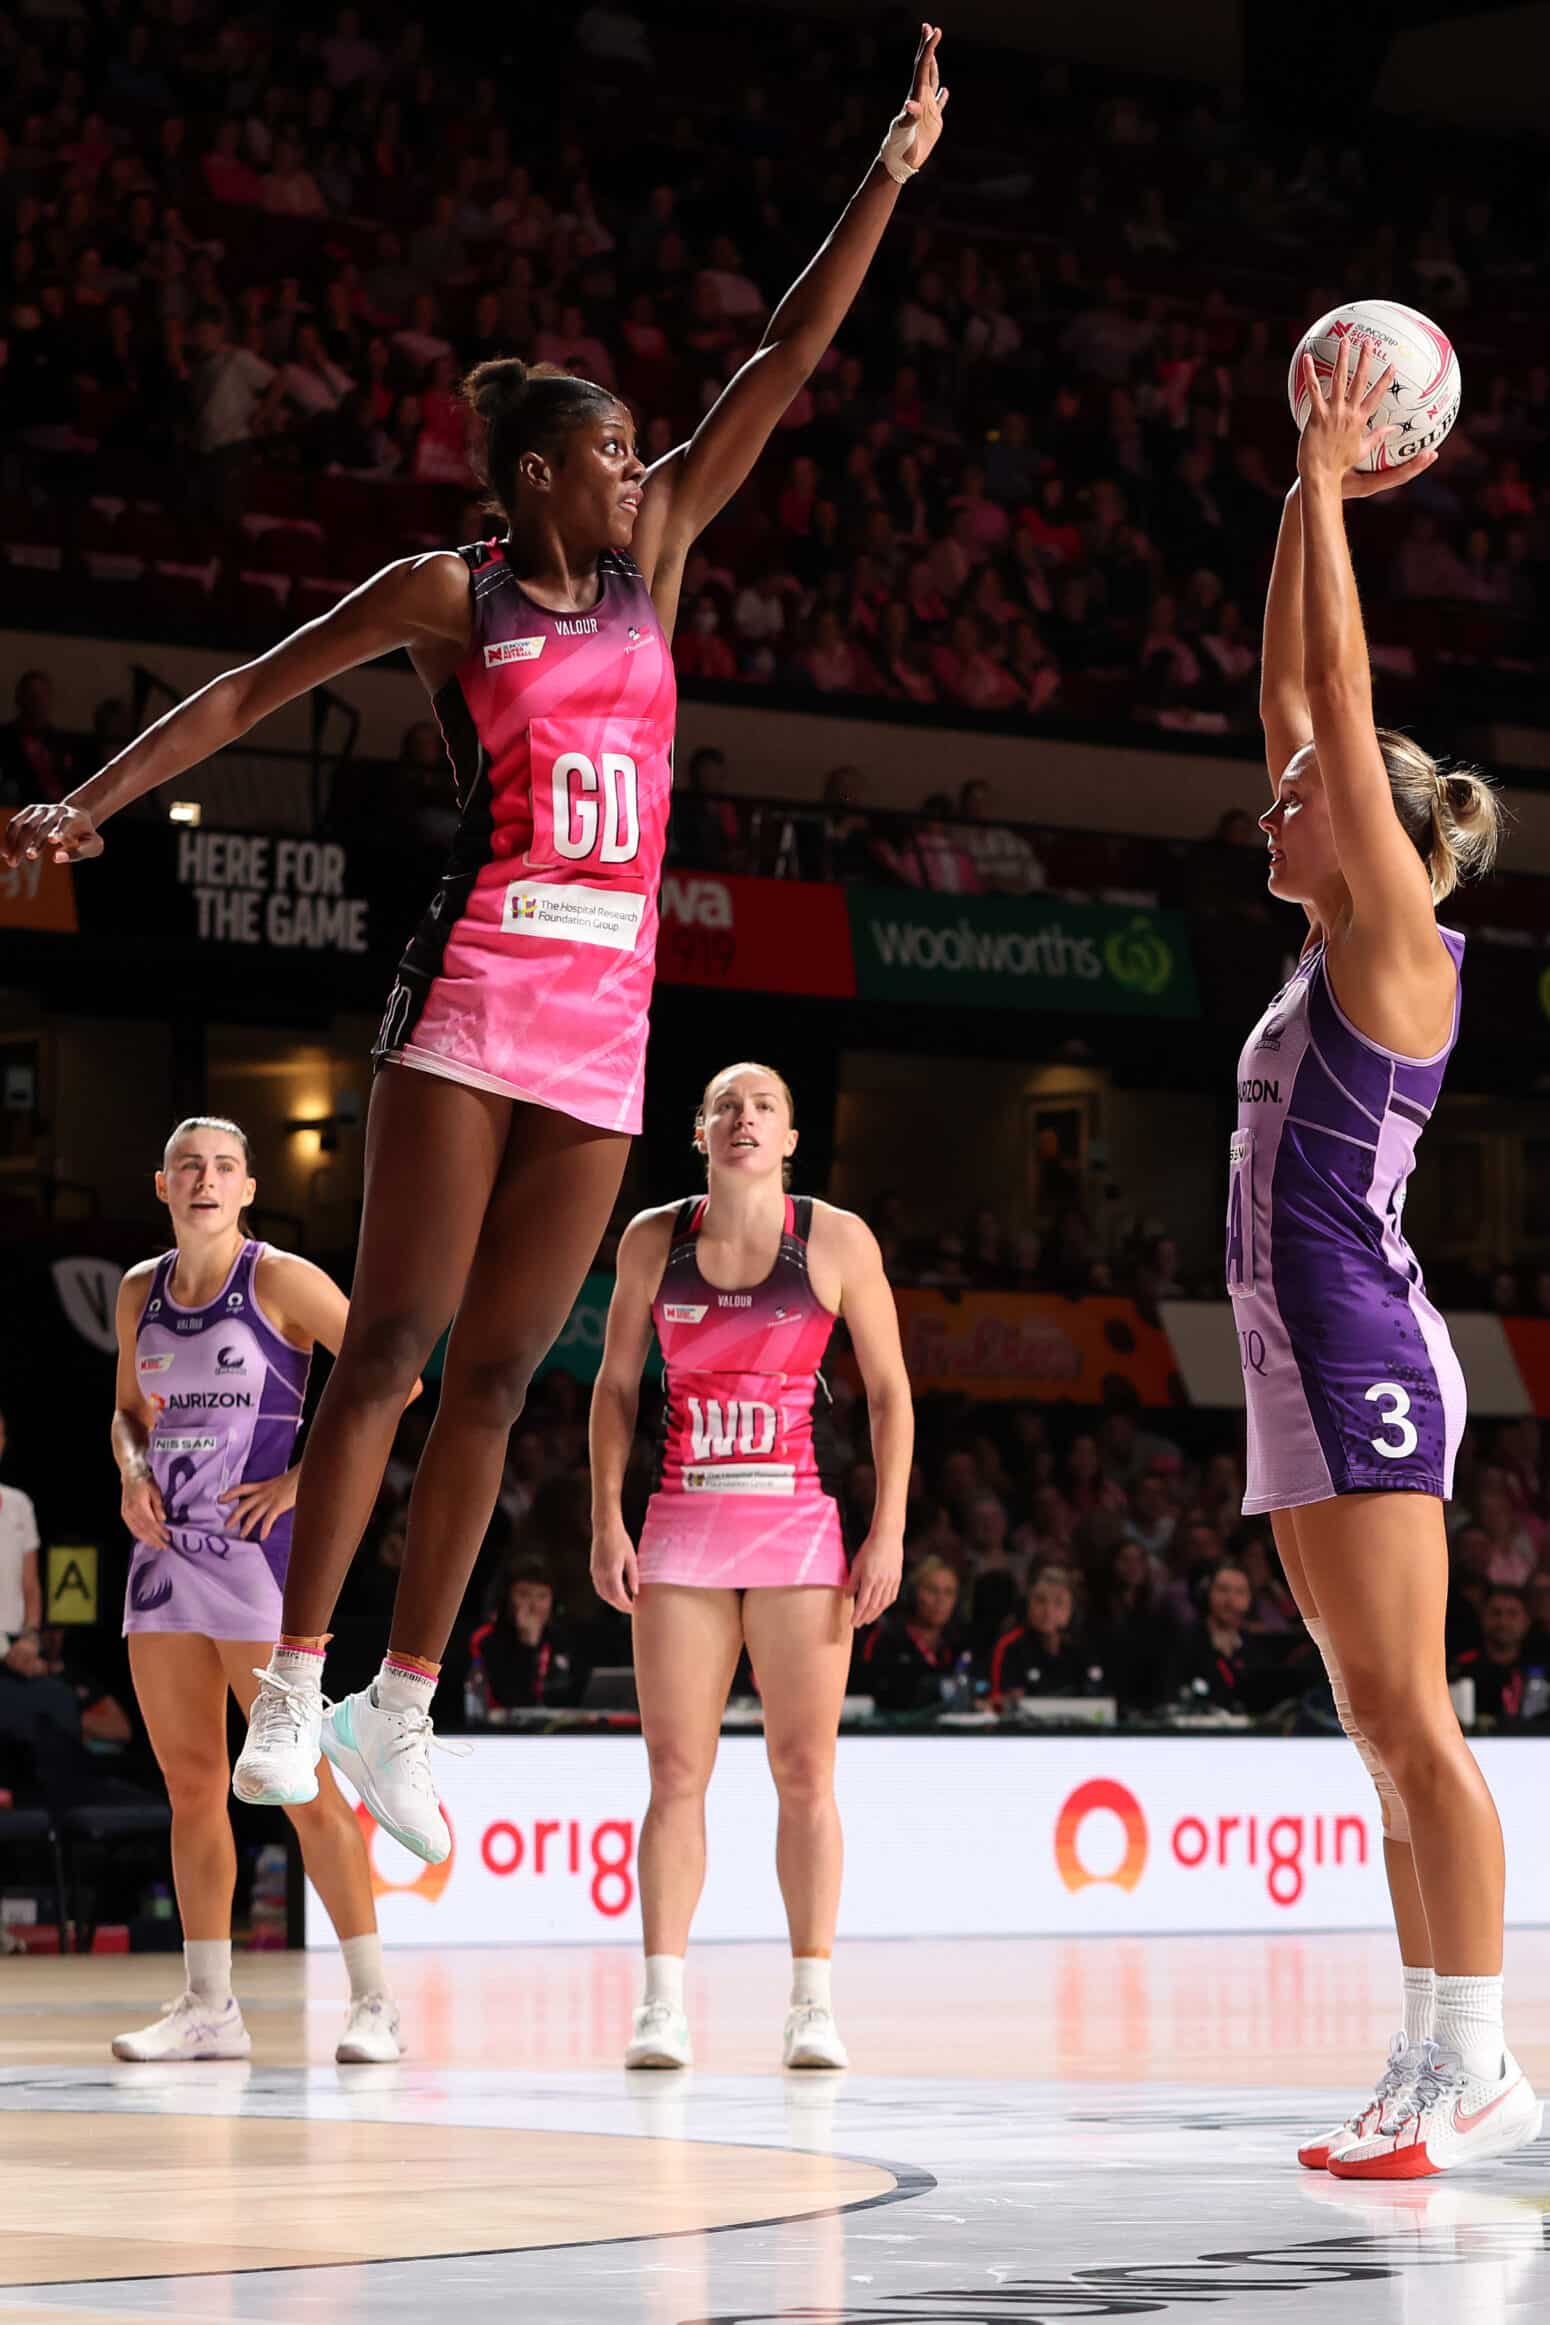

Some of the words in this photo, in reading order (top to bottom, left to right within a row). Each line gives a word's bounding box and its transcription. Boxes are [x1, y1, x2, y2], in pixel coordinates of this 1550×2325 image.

[1349, 336, 1387, 361] NEALL
[555, 618, 598, 636] VALOUR
[552, 752, 640, 863] GD
[177, 831, 268, 886] HERE
[276, 841, 345, 896] FOR
[193, 887, 260, 941] THE
[267, 894, 369, 951] GAME
[538, 911, 592, 927] Foundation
[593, 917, 619, 932] Group
[541, 900, 559, 911] The
[560, 902, 597, 915] Hospital
[598, 907, 638, 923] Research
[872, 919, 1101, 979] Woolworths
[718, 1295, 752, 1307] VALOUR
[156, 1438, 214, 1449] NISSAN
[688, 1397, 777, 1460] WD
[1365, 1382, 1418, 1459] 3
[54, 1560, 91, 1601] A
[480, 1819, 634, 1917] orig
[1171, 1814, 1369, 1905] origin
